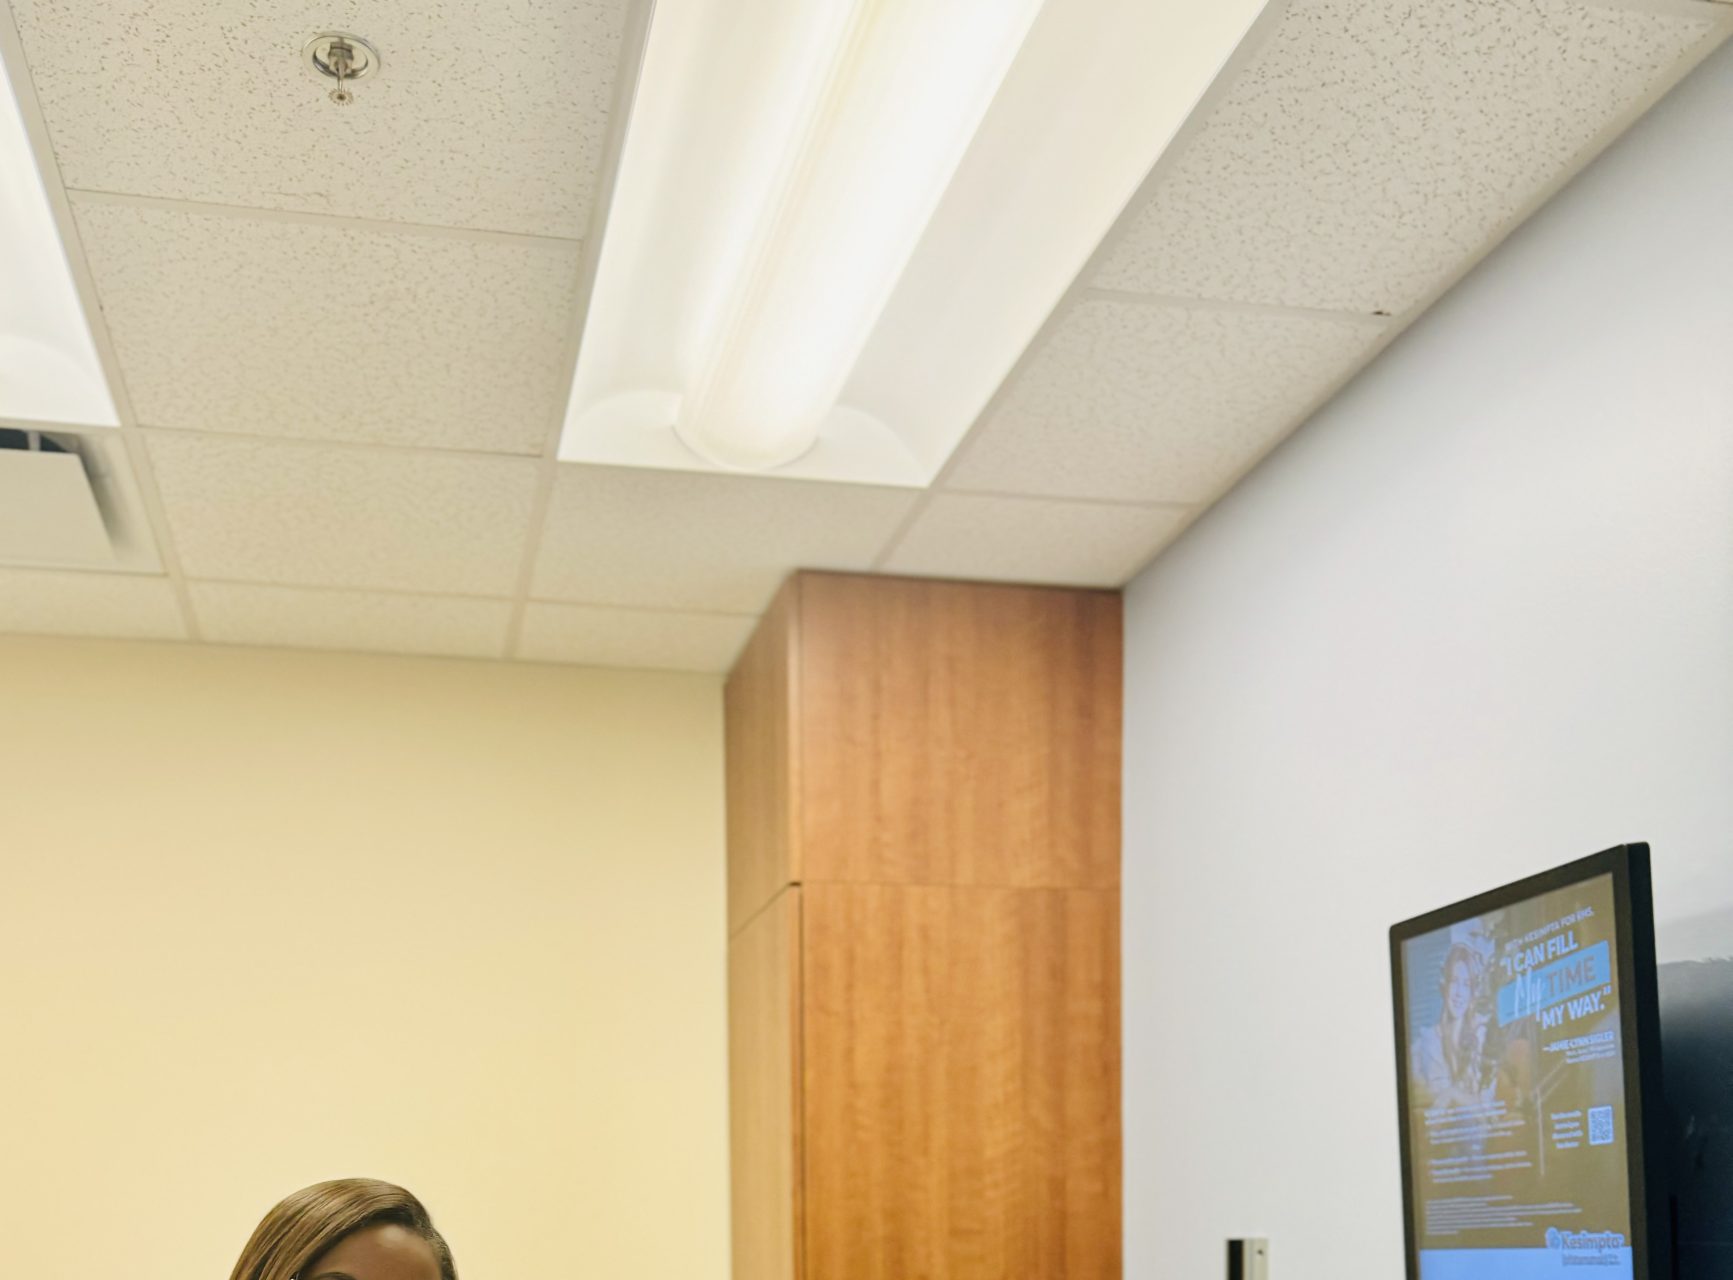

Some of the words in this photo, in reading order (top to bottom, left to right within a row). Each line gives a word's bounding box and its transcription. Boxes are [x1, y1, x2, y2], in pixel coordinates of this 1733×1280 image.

[1514, 943, 1546, 972] CAN
[1547, 930, 1579, 960] FILL
[1548, 955, 1597, 996] TIME
[1542, 1004, 1565, 1030] MY
